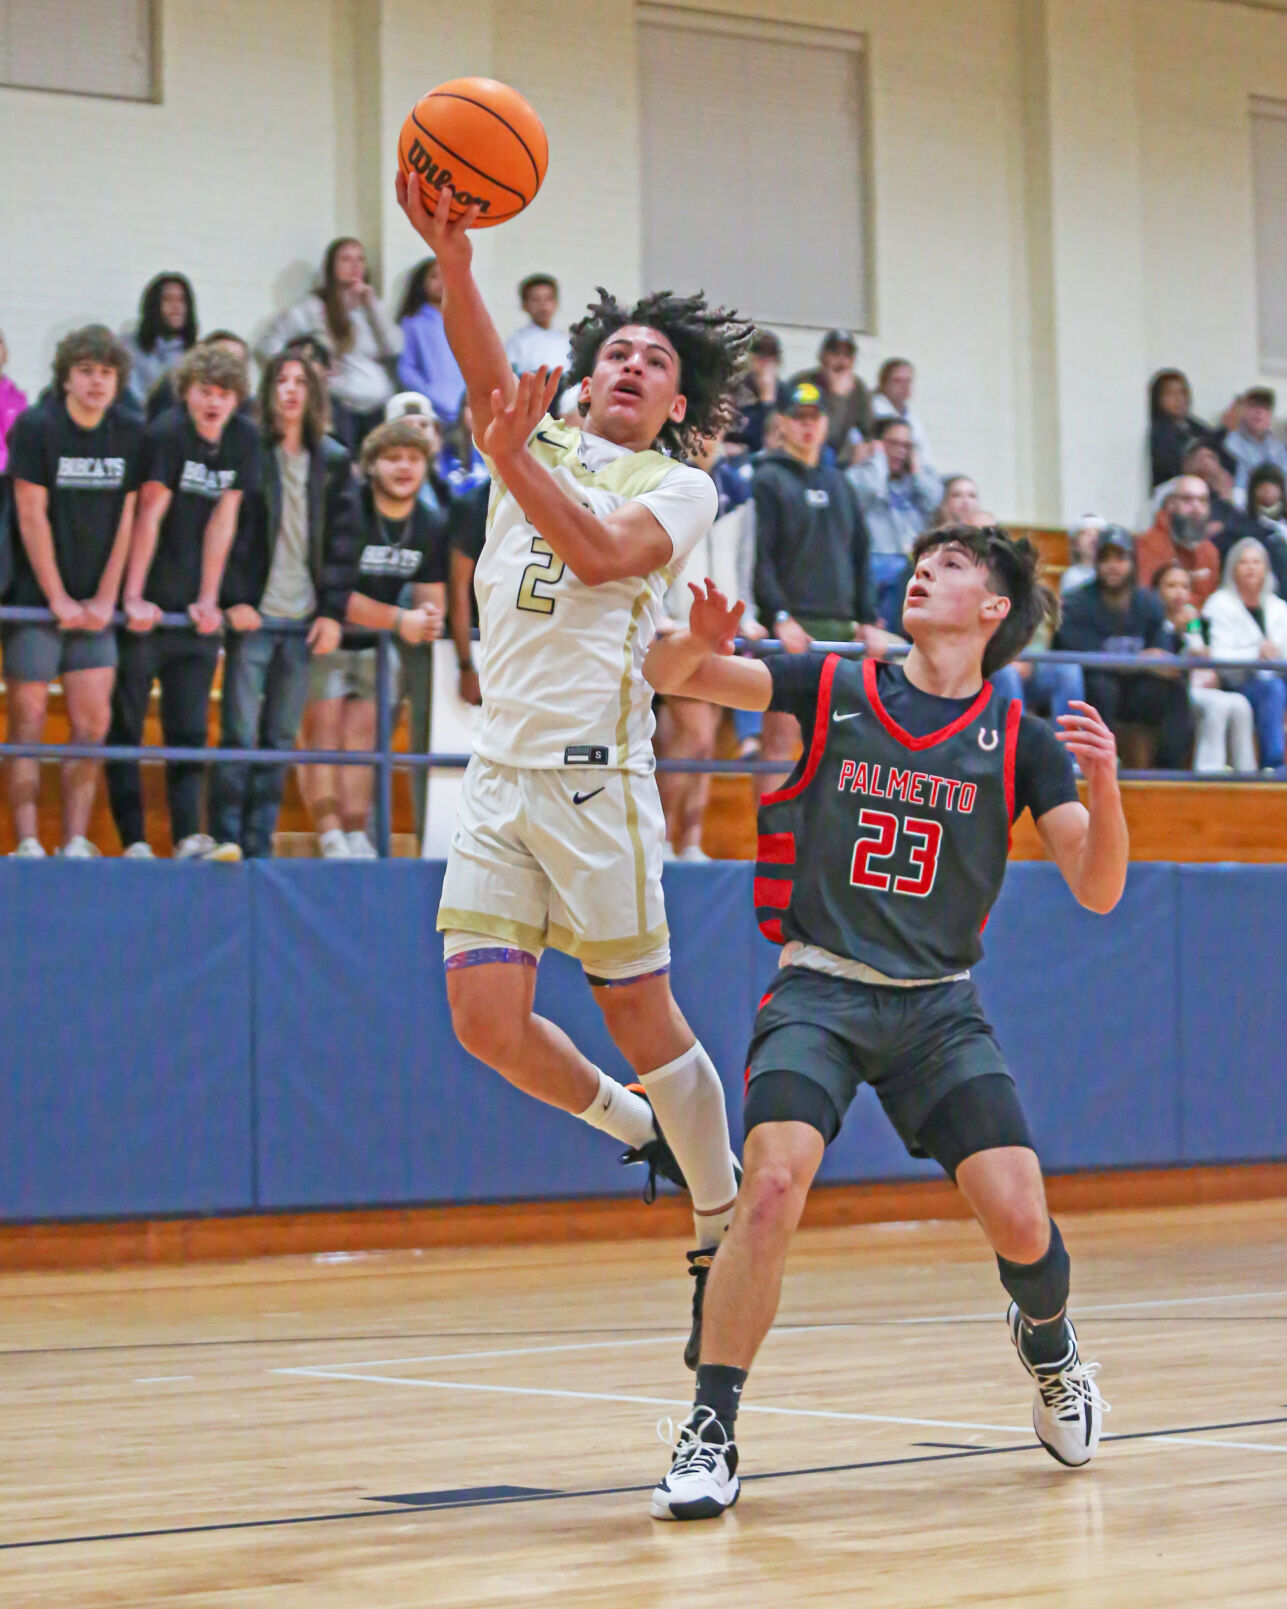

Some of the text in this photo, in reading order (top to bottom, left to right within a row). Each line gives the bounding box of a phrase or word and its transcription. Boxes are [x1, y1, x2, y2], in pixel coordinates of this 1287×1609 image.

[517, 537, 565, 614] 2
[595, 750, 602, 759] S
[838, 759, 977, 814] PALMETTO
[850, 808, 943, 897] 23
